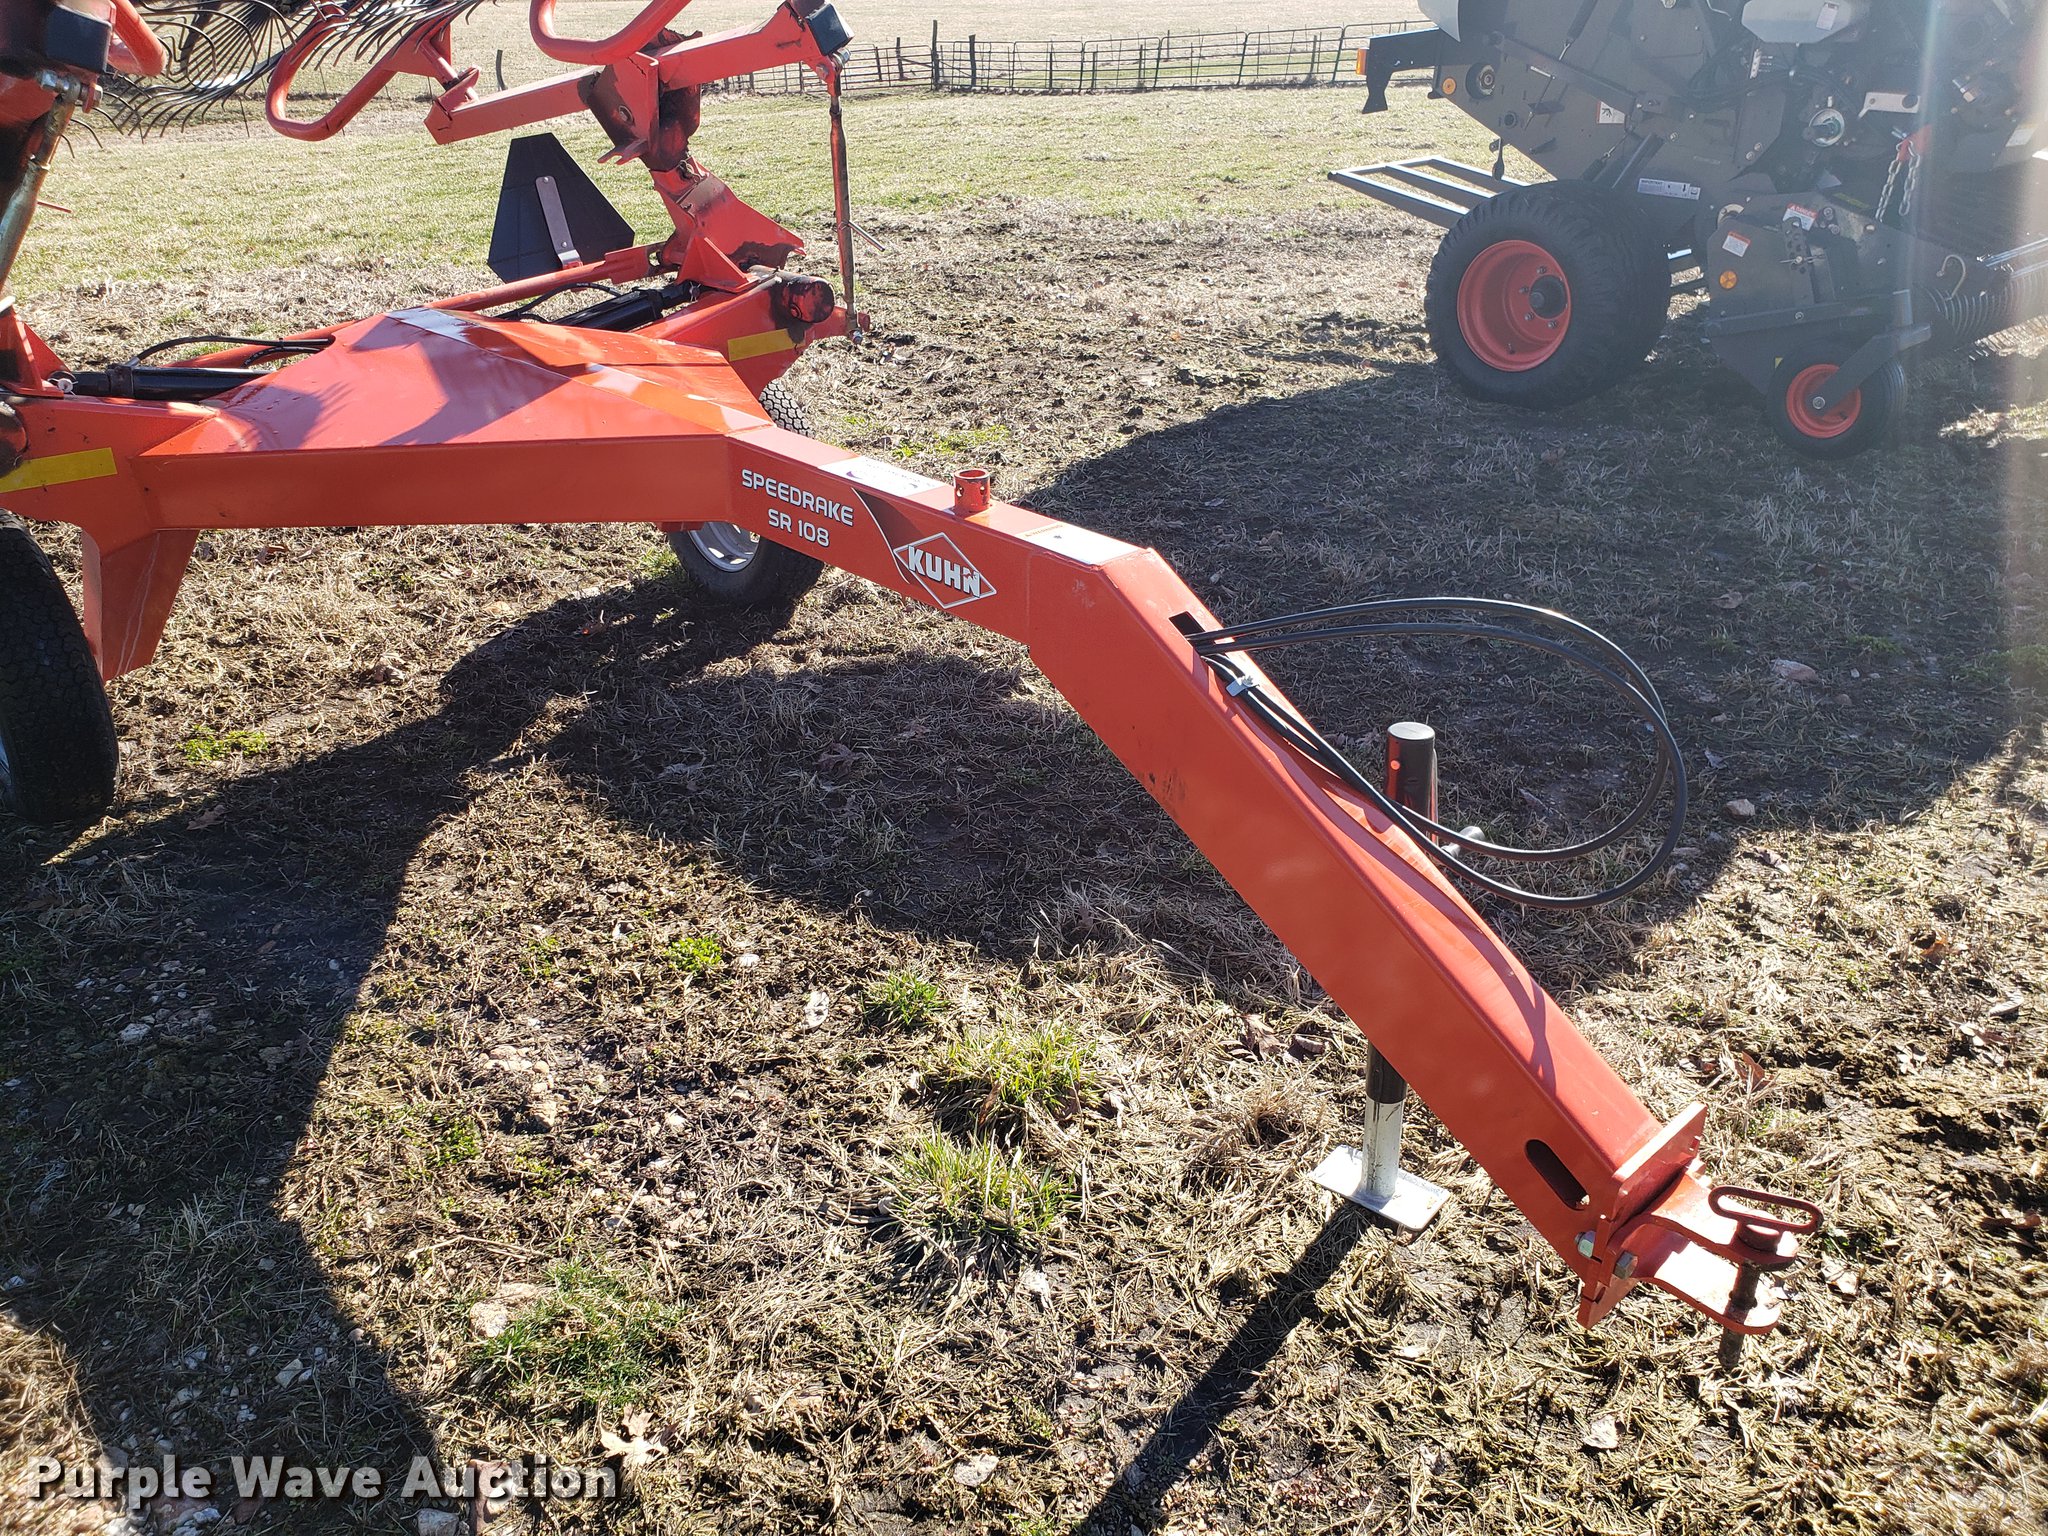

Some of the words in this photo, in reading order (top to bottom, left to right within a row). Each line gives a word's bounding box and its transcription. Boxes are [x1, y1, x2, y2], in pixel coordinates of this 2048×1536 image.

[741, 468, 854, 527] SPEEDRAKE
[768, 508, 792, 533] SR
[798, 519, 830, 547] 108
[908, 545, 981, 598] KUHN
